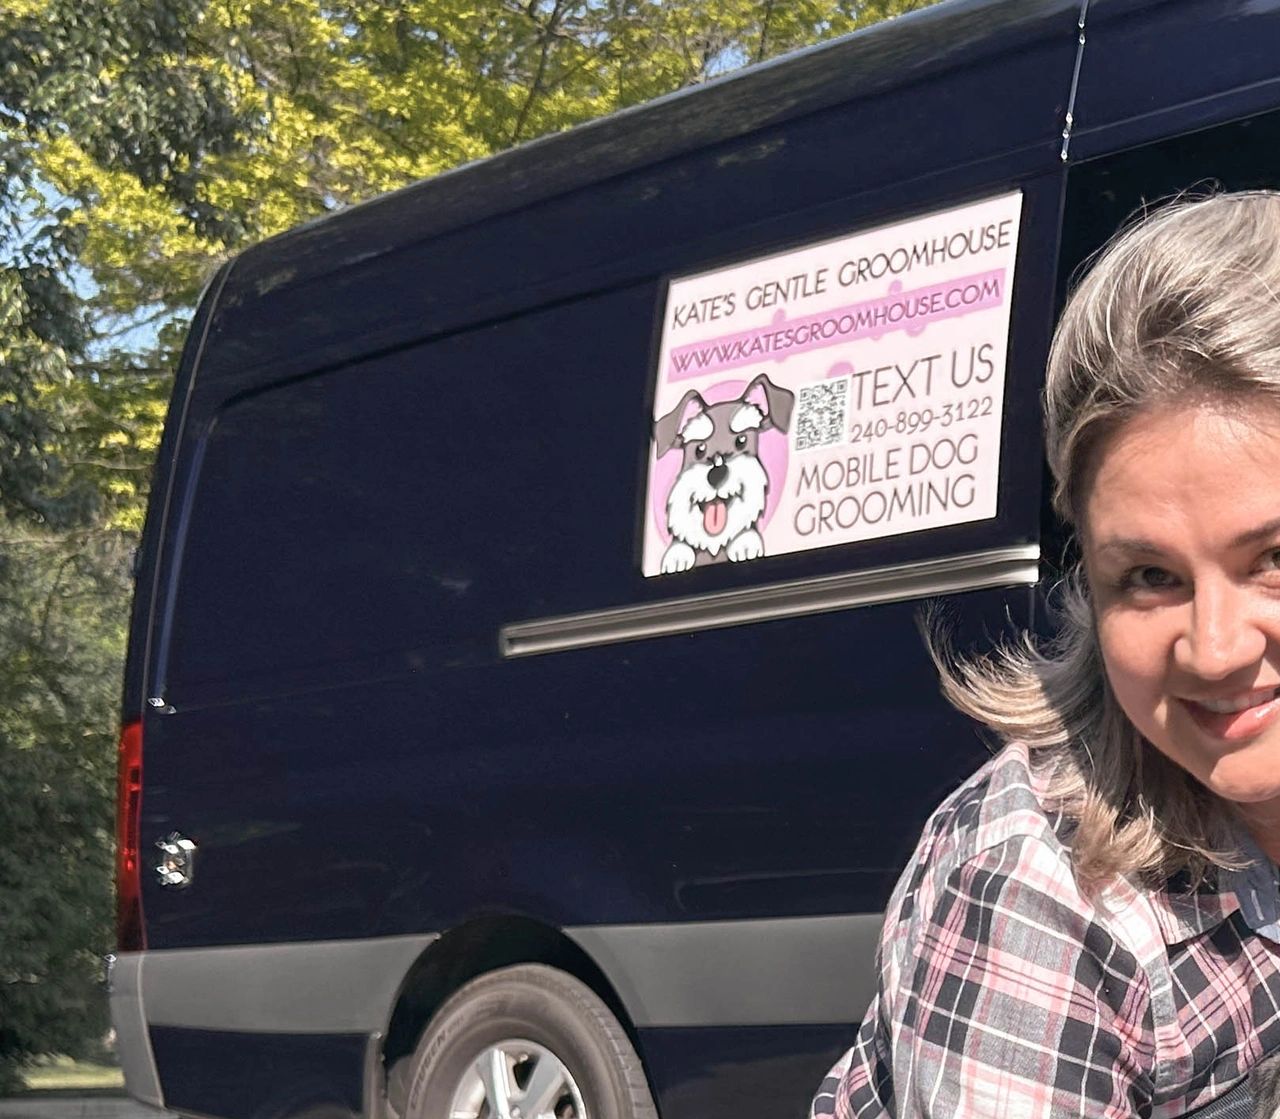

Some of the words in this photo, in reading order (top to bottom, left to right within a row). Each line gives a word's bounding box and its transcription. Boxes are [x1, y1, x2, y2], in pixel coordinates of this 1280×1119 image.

[672, 292, 736, 329] KATE'S
[745, 268, 829, 311] GENTLE
[838, 219, 1014, 287] GROOMHOUSE
[670, 279, 1000, 373] WWW.KATESGROOMHOUSE.COM
[852, 354, 942, 411] TEXT
[951, 343, 995, 389] US
[851, 396, 993, 444] 240-899-3122
[796, 448, 901, 498] MOBILE
[908, 433, 979, 474] DOG
[793, 474, 976, 536] GROOMING
